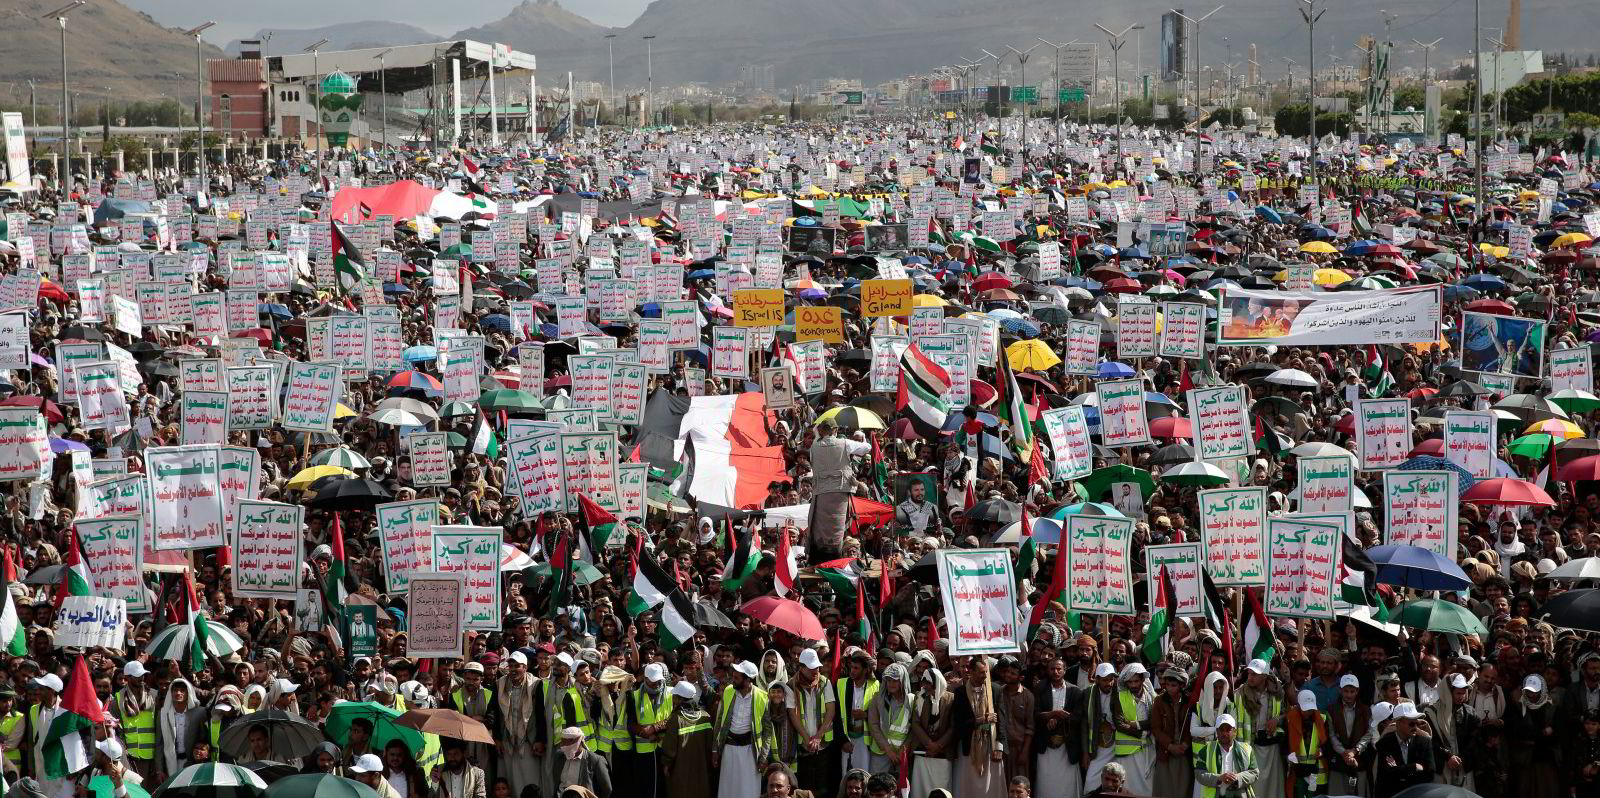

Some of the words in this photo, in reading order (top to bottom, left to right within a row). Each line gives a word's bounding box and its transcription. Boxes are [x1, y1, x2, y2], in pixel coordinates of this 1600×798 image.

[734, 292, 783, 308] سرطانية
[868, 298, 902, 313] Gland
[802, 308, 834, 324] غدة
[1354, 317, 1374, 326] اليهود
[1101, 386, 1139, 401] قاطعوا
[186, 399, 224, 409] قاطعوا
[1364, 407, 1405, 421] قاطعوا
[1448, 422, 1488, 434] قاطعوا
[153, 459, 214, 480] قاطعوا
[1304, 465, 1348, 482] قاطعوا
[566, 484, 584, 494] اليهود
[1420, 500, 1445, 510] الموت
[1236, 518, 1260, 529] الموت
[272, 531, 295, 541] الموت
[1237, 534, 1260, 545] الموت
[271, 546, 295, 556] الموت
[1105, 546, 1125, 558] الموت
[1208, 552, 1227, 562] اليهود
[1153, 552, 1194, 566] قاطعوا
[1306, 554, 1331, 563] الموت
[240, 560, 260, 570] اليهود
[390, 559, 410, 572] اليهود
[470, 560, 494, 572] الموت
[950, 560, 1005, 580] قاطعوا
[1105, 562, 1126, 574] الموت
[1240, 565, 1262, 580] النصر
[1306, 570, 1330, 580] الموت
[271, 574, 293, 588] النصر
[1073, 577, 1094, 588] اليهود
[1271, 582, 1293, 593] اليهود
[1104, 593, 1128, 608] النصر
[1304, 599, 1329, 615] النصر
[102, 605, 121, 631] أين
[470, 610, 494, 624] النصر
